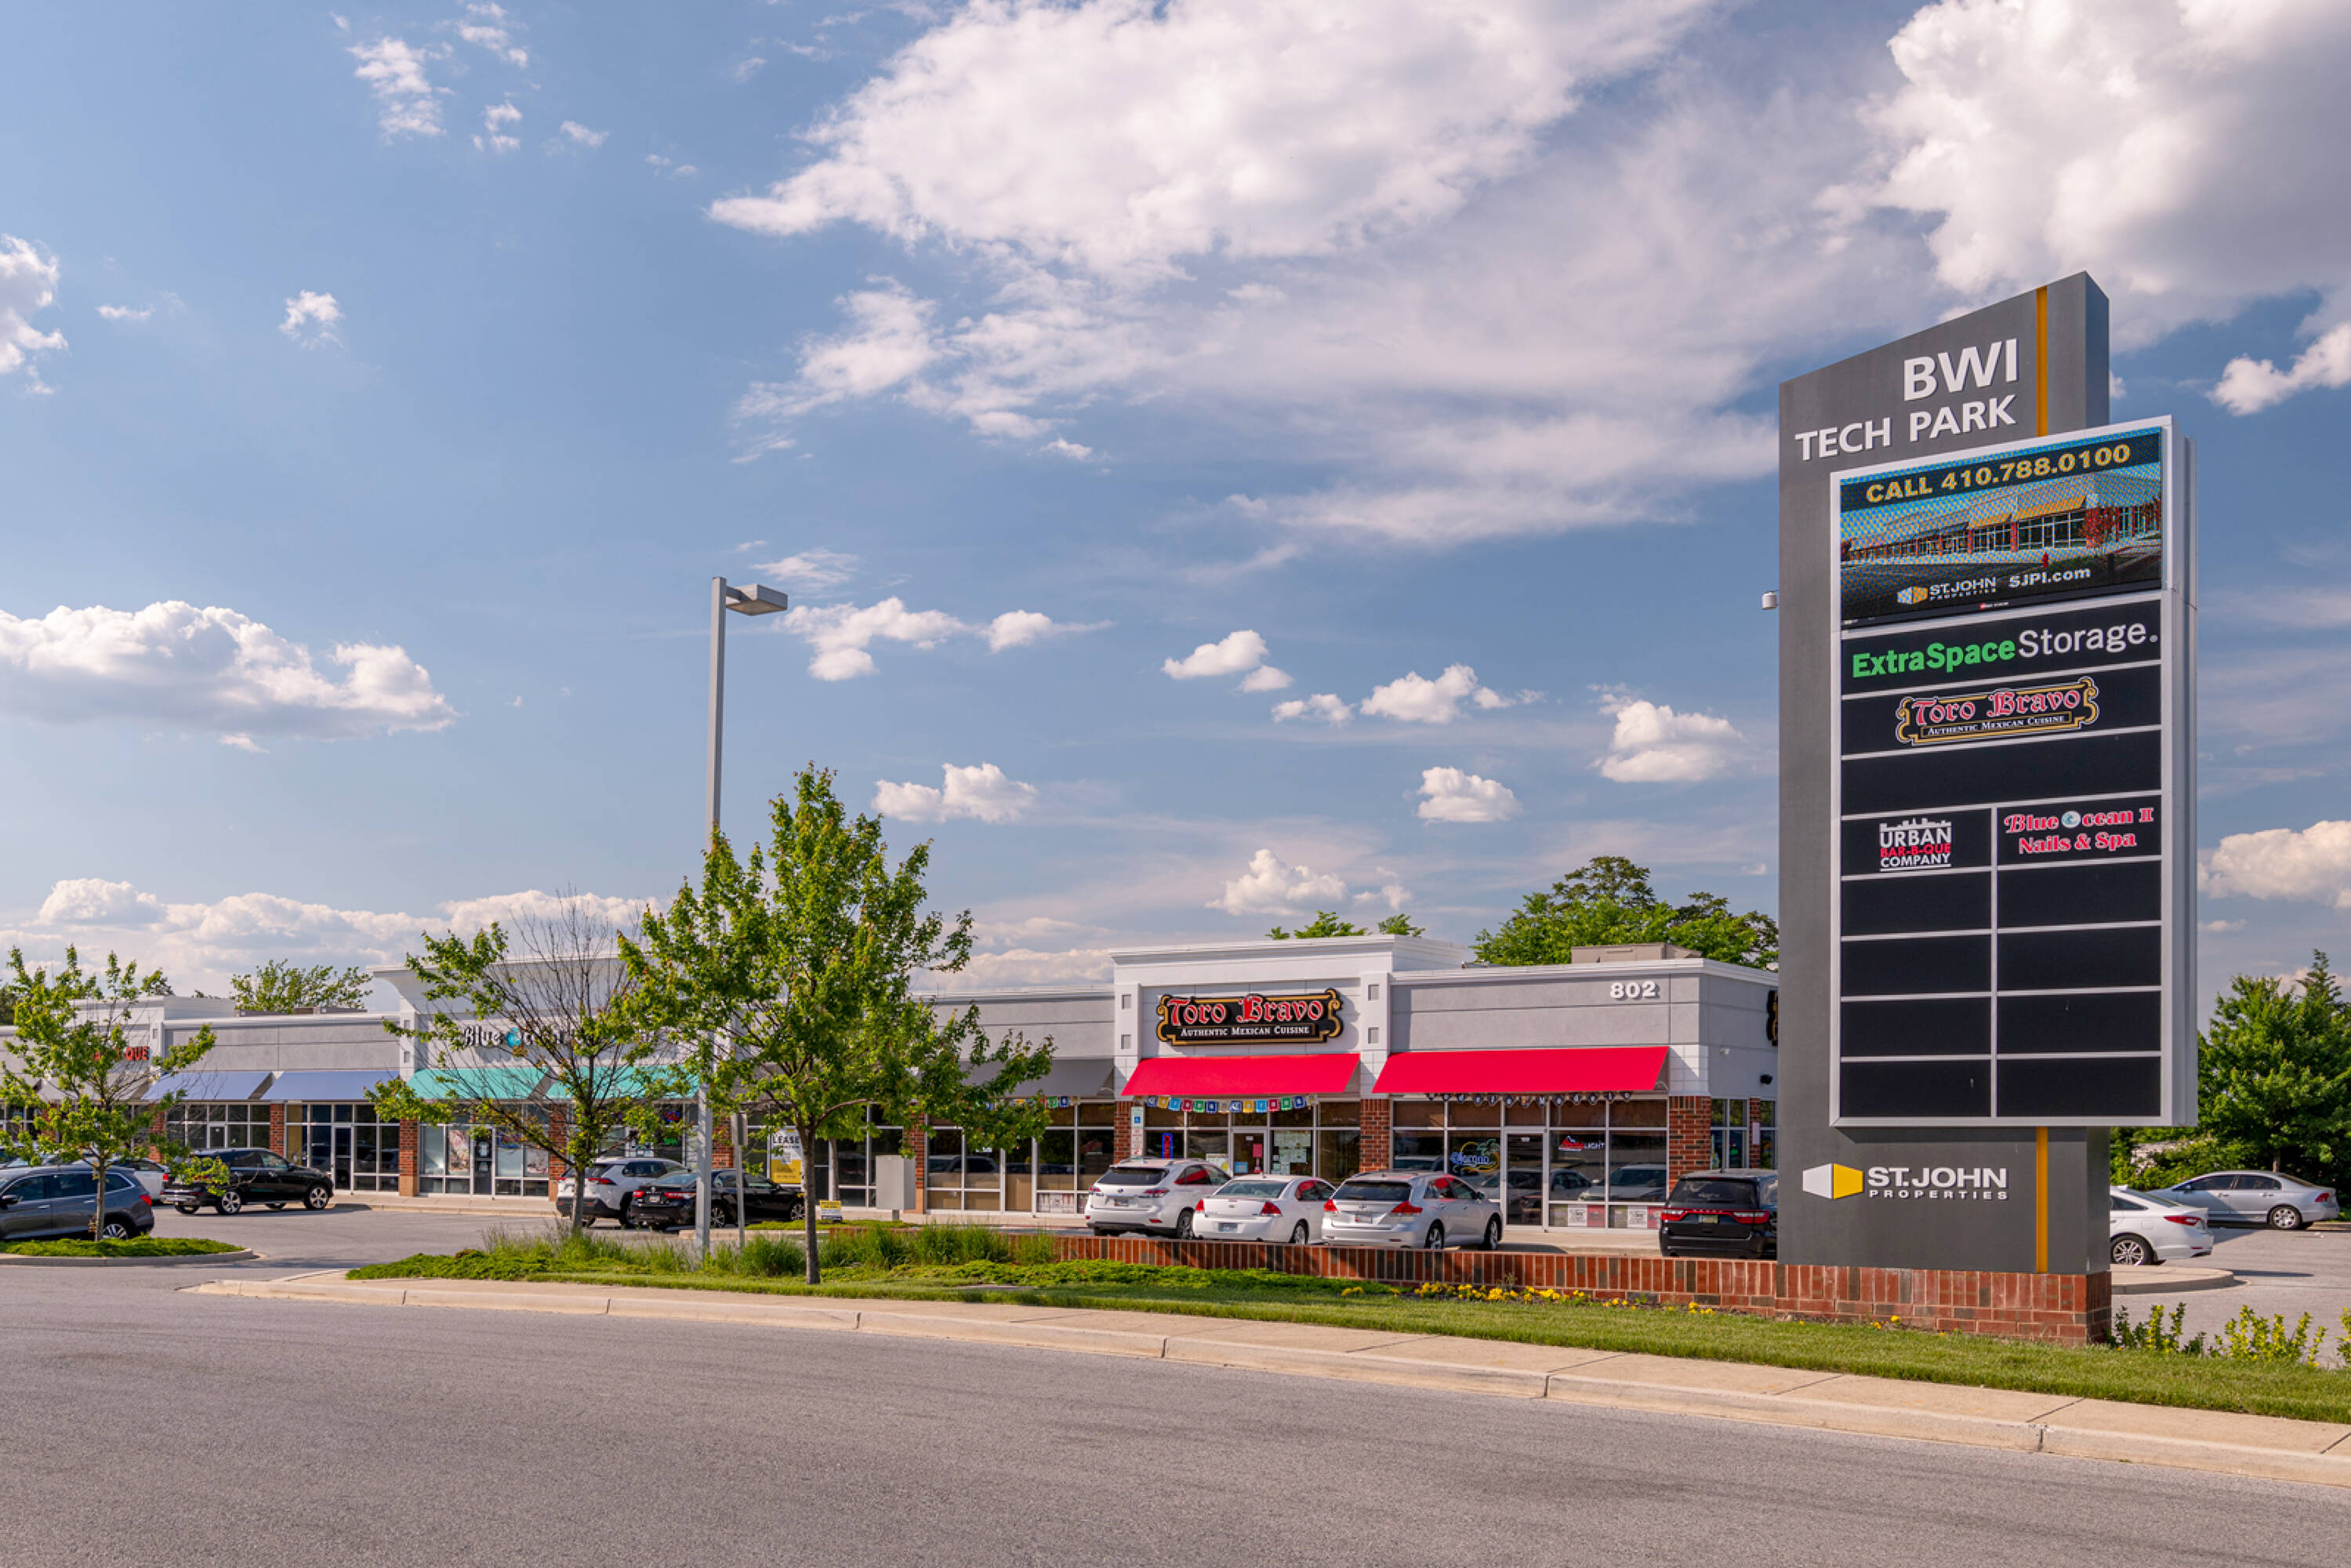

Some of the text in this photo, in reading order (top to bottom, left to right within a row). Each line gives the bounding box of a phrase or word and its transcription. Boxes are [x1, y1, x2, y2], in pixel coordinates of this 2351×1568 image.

[1904, 338, 2019, 402] BWI
[1795, 394, 2017, 461] TECH PARK
[1867, 444, 2131, 503] CALL 410.788.0100
[1912, 689, 2080, 726] Toro Bravo
[2004, 814, 2059, 833] Blue
[2139, 808, 2154, 822] II
[1880, 826, 1951, 848] URBAN
[2019, 831, 2137, 855] Nails & Spa
[1880, 842, 1951, 858] BAR-B-QUE
[1880, 852, 1950, 868] COMPANY
[1610, 980, 1656, 999] 802
[1168, 995, 1323, 1026] Toro Bravo
[772, 1135, 800, 1144] LEASE
[1869, 1190, 2008, 1200] PROPERTIES
